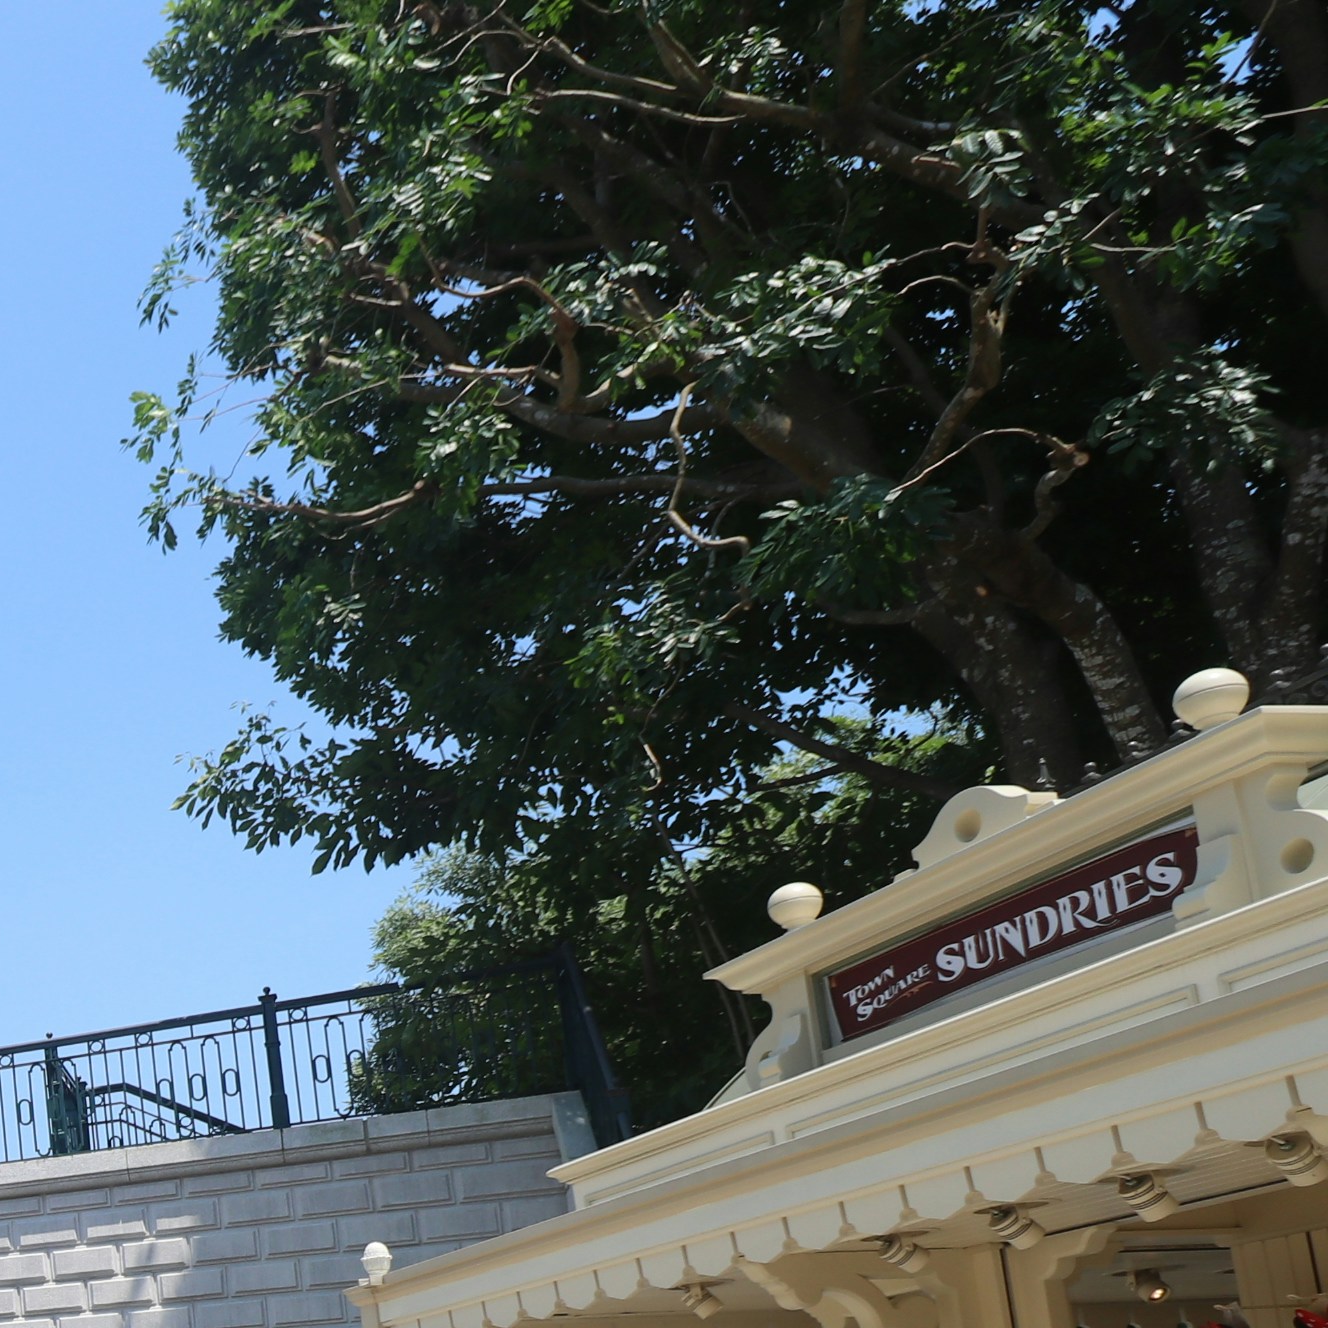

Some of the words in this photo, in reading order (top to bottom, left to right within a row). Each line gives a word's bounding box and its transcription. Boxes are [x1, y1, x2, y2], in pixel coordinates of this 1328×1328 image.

[935, 852, 1183, 983] SUNDRIES
[843, 965, 895, 1007] TOWN
[856, 964, 932, 1021] SQUARE
